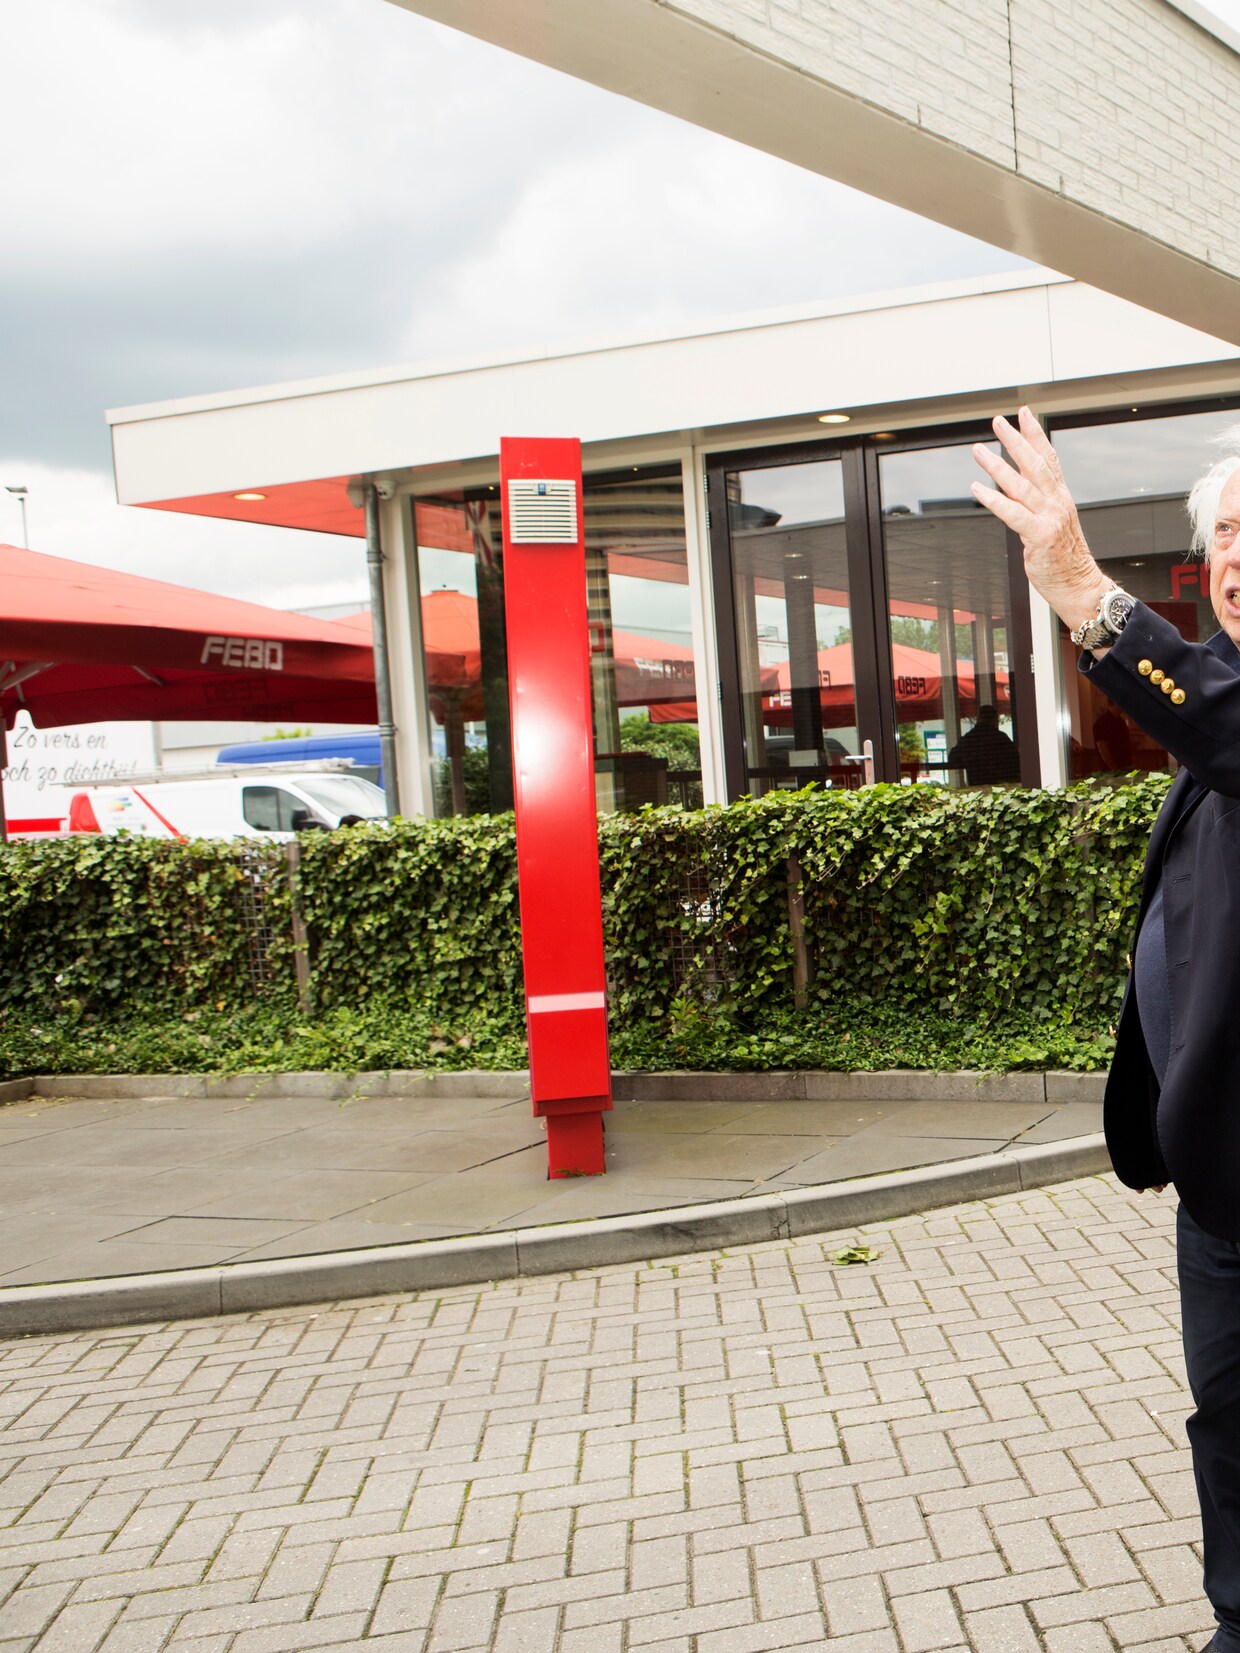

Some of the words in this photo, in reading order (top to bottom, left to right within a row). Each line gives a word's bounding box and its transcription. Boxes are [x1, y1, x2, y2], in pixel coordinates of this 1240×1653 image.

[200, 636, 283, 671] FEBO
[13, 726, 37, 749] Zo
[86, 734, 107, 749] en
